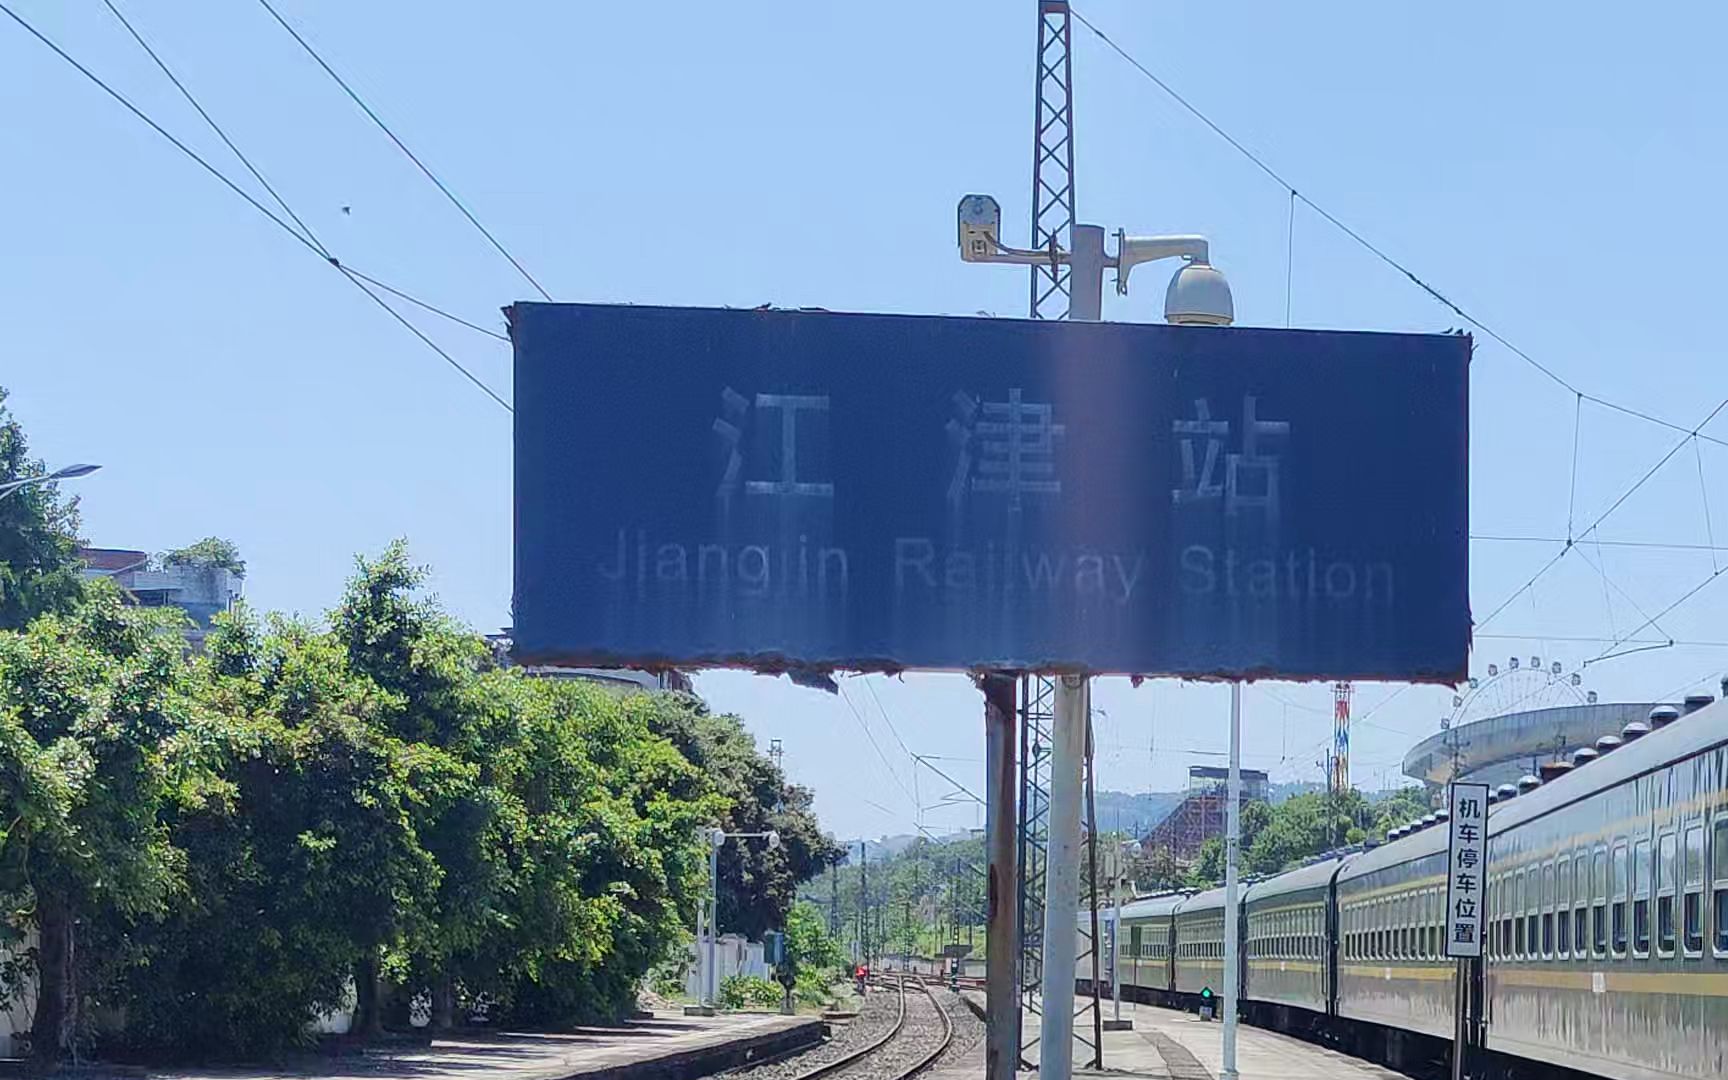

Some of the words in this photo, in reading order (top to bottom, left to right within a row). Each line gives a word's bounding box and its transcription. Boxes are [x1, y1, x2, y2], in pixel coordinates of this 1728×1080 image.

[712, 386, 1290, 510] 江津站
[895, 538, 1146, 604] Railway
[1179, 544, 1397, 600] Station
[1453, 798, 1481, 943] 机车停车位置
